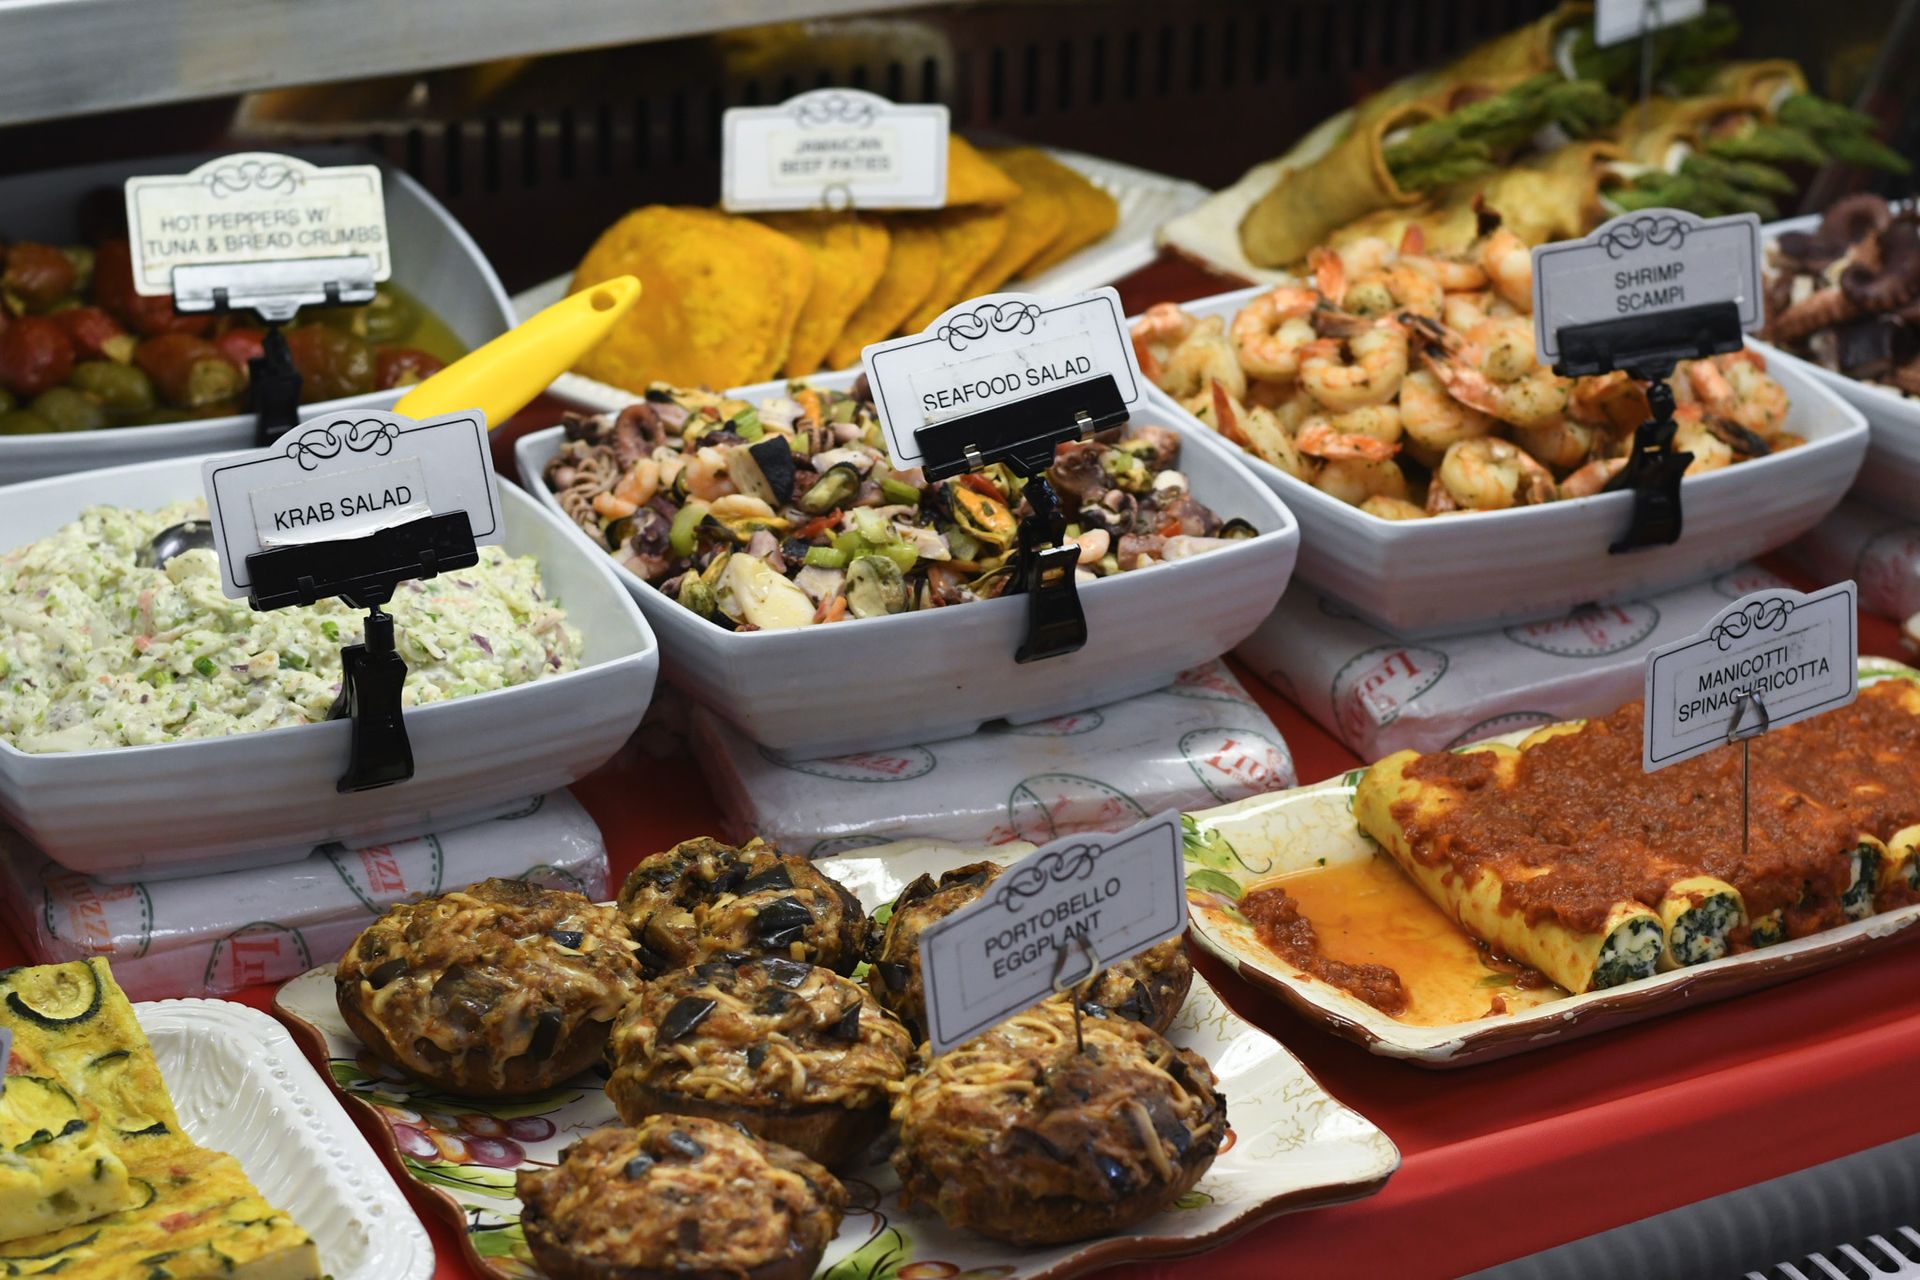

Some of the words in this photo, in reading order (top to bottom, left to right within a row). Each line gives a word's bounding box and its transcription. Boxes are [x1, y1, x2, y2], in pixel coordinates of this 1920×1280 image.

[780, 159, 822, 174] BEEF
[161, 214, 202, 232] HOT
[207, 208, 299, 229] PEPPERS
[306, 206, 332, 223] W/
[147, 238, 199, 256] TUNA
[204, 234, 219, 251] &
[224, 231, 292, 251] BREAD
[299, 225, 382, 246] CRUMBS
[1615, 262, 1685, 290] SHRIMP
[1616, 285, 1685, 313] SCAMPI
[923, 373, 1020, 411] SEAFOOD
[1026, 356, 1091, 386] SALAD
[274, 502, 335, 531] KRAB
[340, 486, 412, 517] SALAD
[1699, 646, 1787, 692] MANICOTTI
[984, 877, 1121, 958] PORTOBELLO
[993, 910, 1102, 979] EGGPLANT
